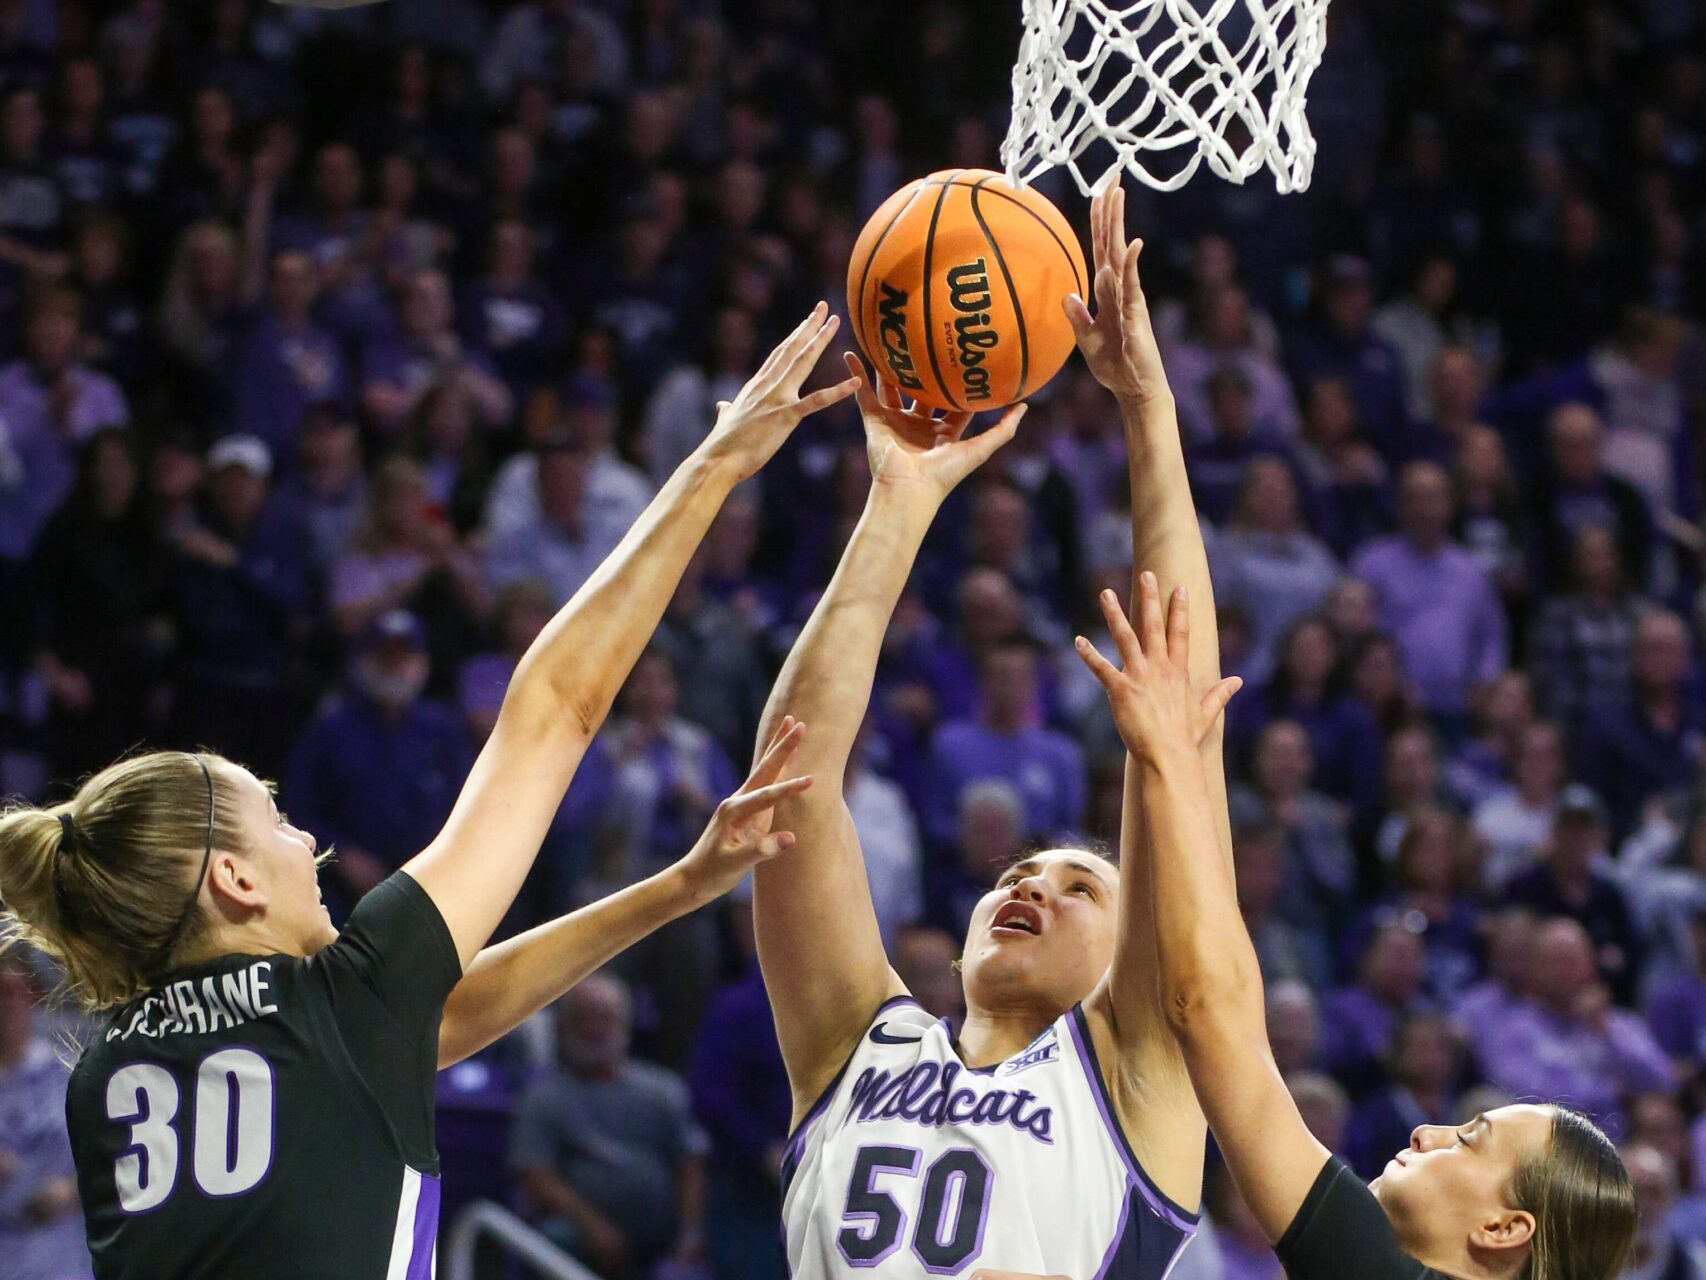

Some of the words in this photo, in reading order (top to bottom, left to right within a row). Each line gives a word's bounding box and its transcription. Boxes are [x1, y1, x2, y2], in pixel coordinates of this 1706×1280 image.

[879, 280, 924, 390] NCAA
[944, 322, 954, 345] EVO
[946, 257, 998, 402] Wilson
[106, 961, 278, 1042] CHRANE
[105, 1044, 277, 1216] 30
[843, 1059, 1055, 1145] Wildcats
[836, 1142, 994, 1276] 50
